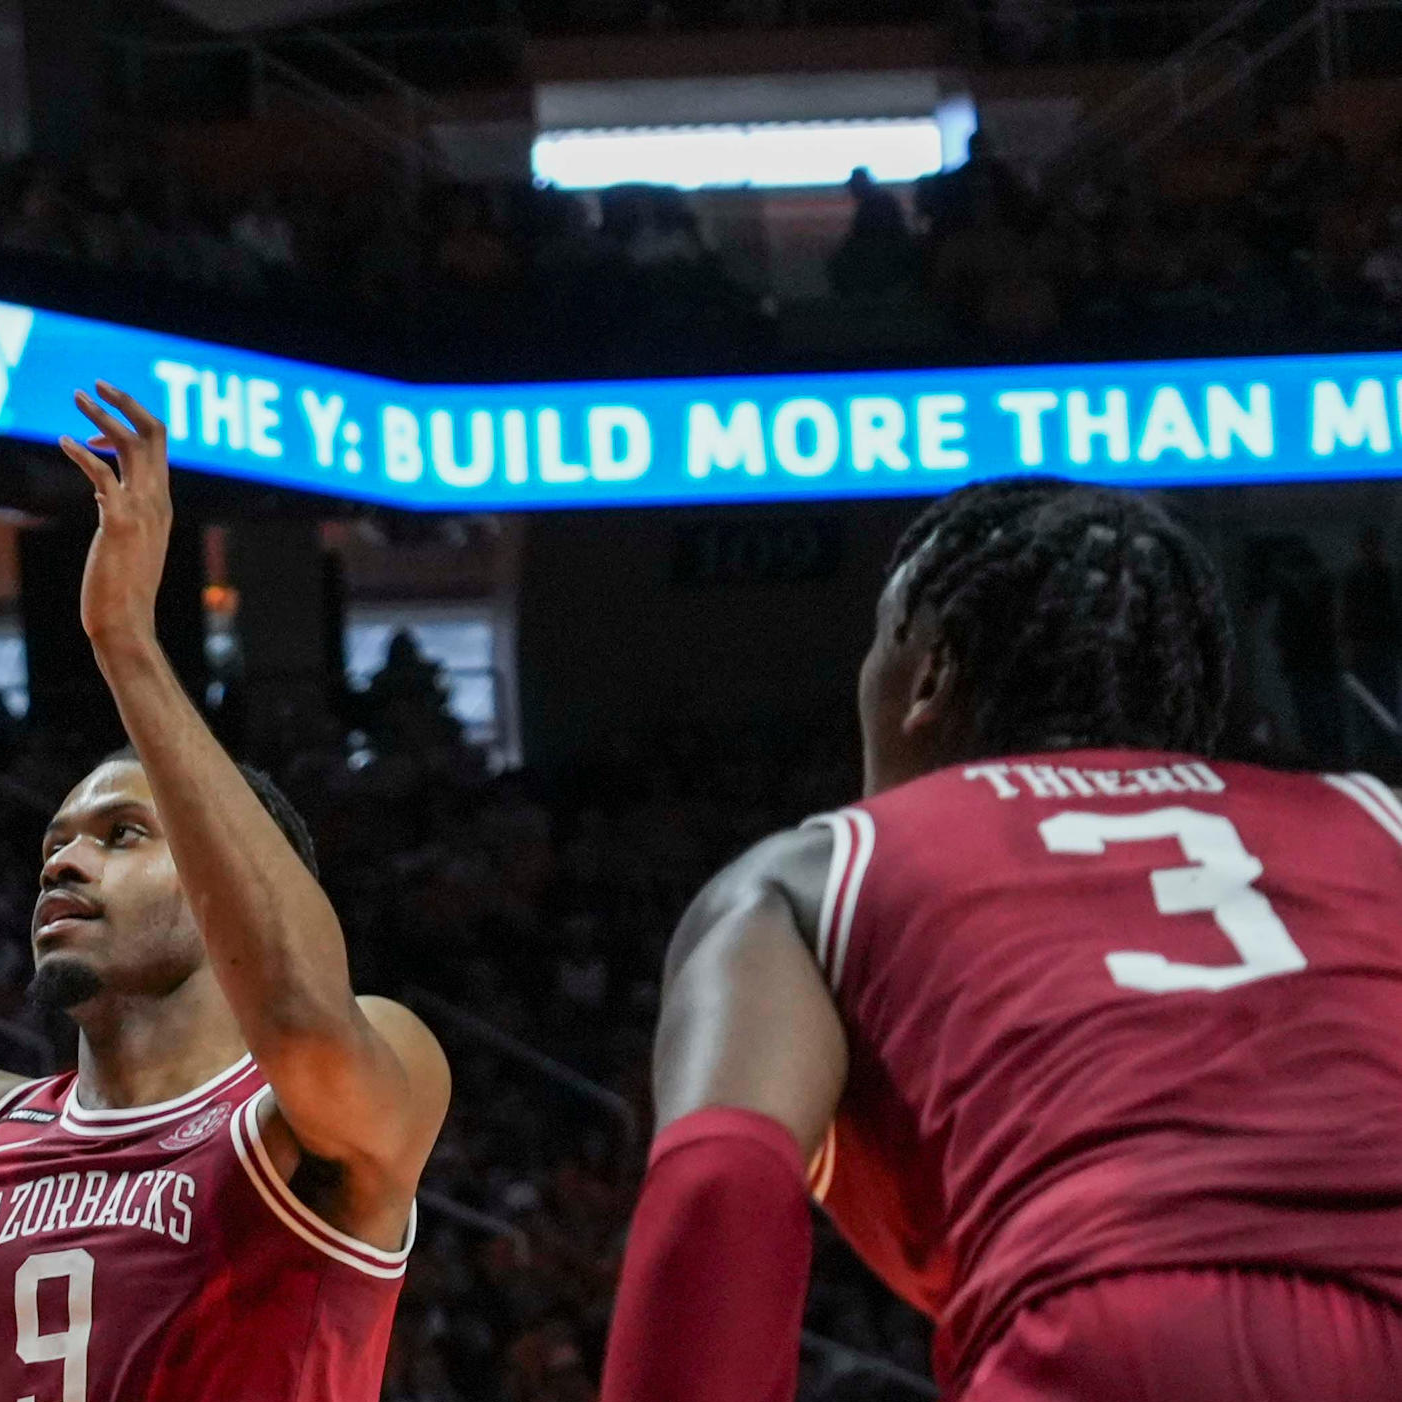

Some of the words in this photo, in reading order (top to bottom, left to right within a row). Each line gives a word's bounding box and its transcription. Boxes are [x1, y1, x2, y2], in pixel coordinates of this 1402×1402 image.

[152, 360, 283, 458] THE
[300, 389, 363, 473] Y:
[382, 404, 652, 488] BUILD
[686, 394, 970, 479] MORE
[997, 382, 1275, 466] THAN
[1311, 378, 1402, 456] M
[1037, 806, 1308, 994] 3
